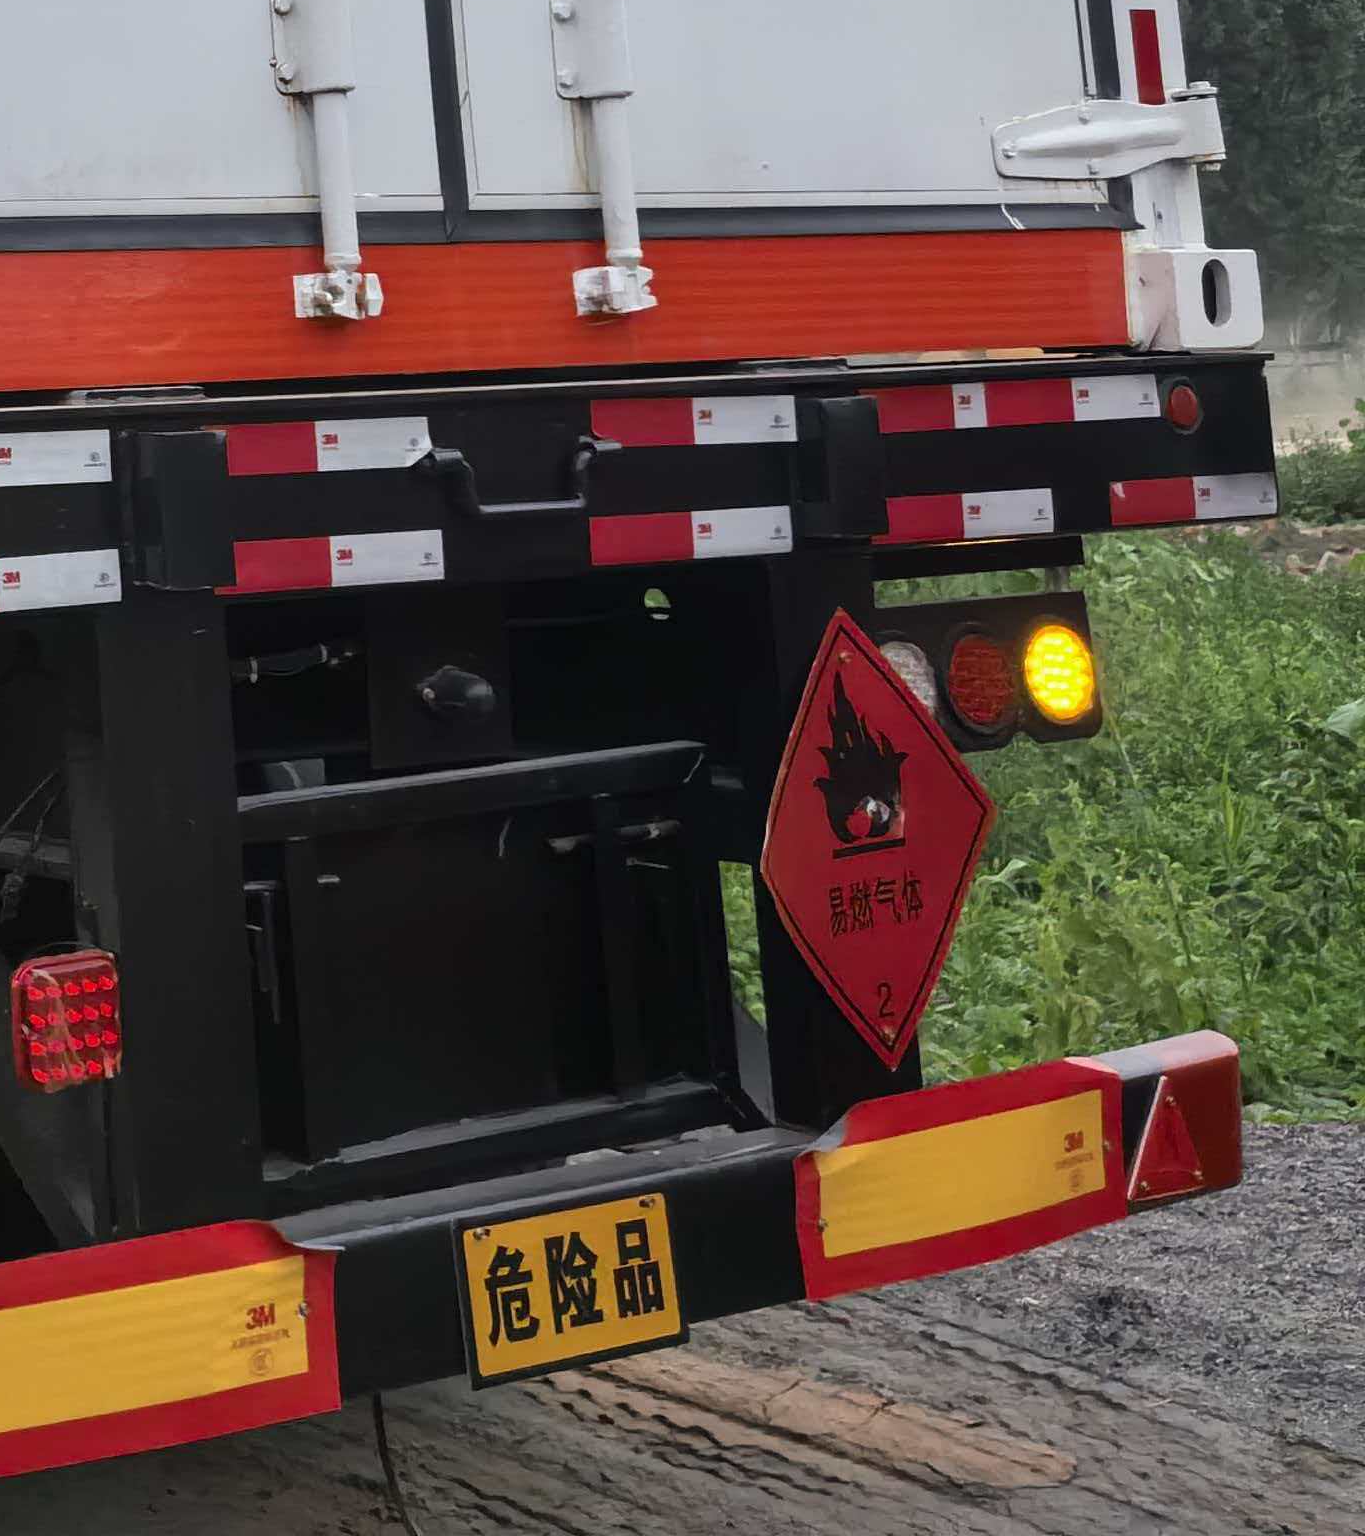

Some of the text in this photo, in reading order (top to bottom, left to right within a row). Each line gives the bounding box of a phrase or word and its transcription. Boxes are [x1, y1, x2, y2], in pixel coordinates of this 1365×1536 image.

[828, 871, 922, 937] 易燃气体
[877, 983, 894, 1017] 2
[484, 1218, 665, 1347] 危险品
[245, 1302, 276, 1330] 3M
